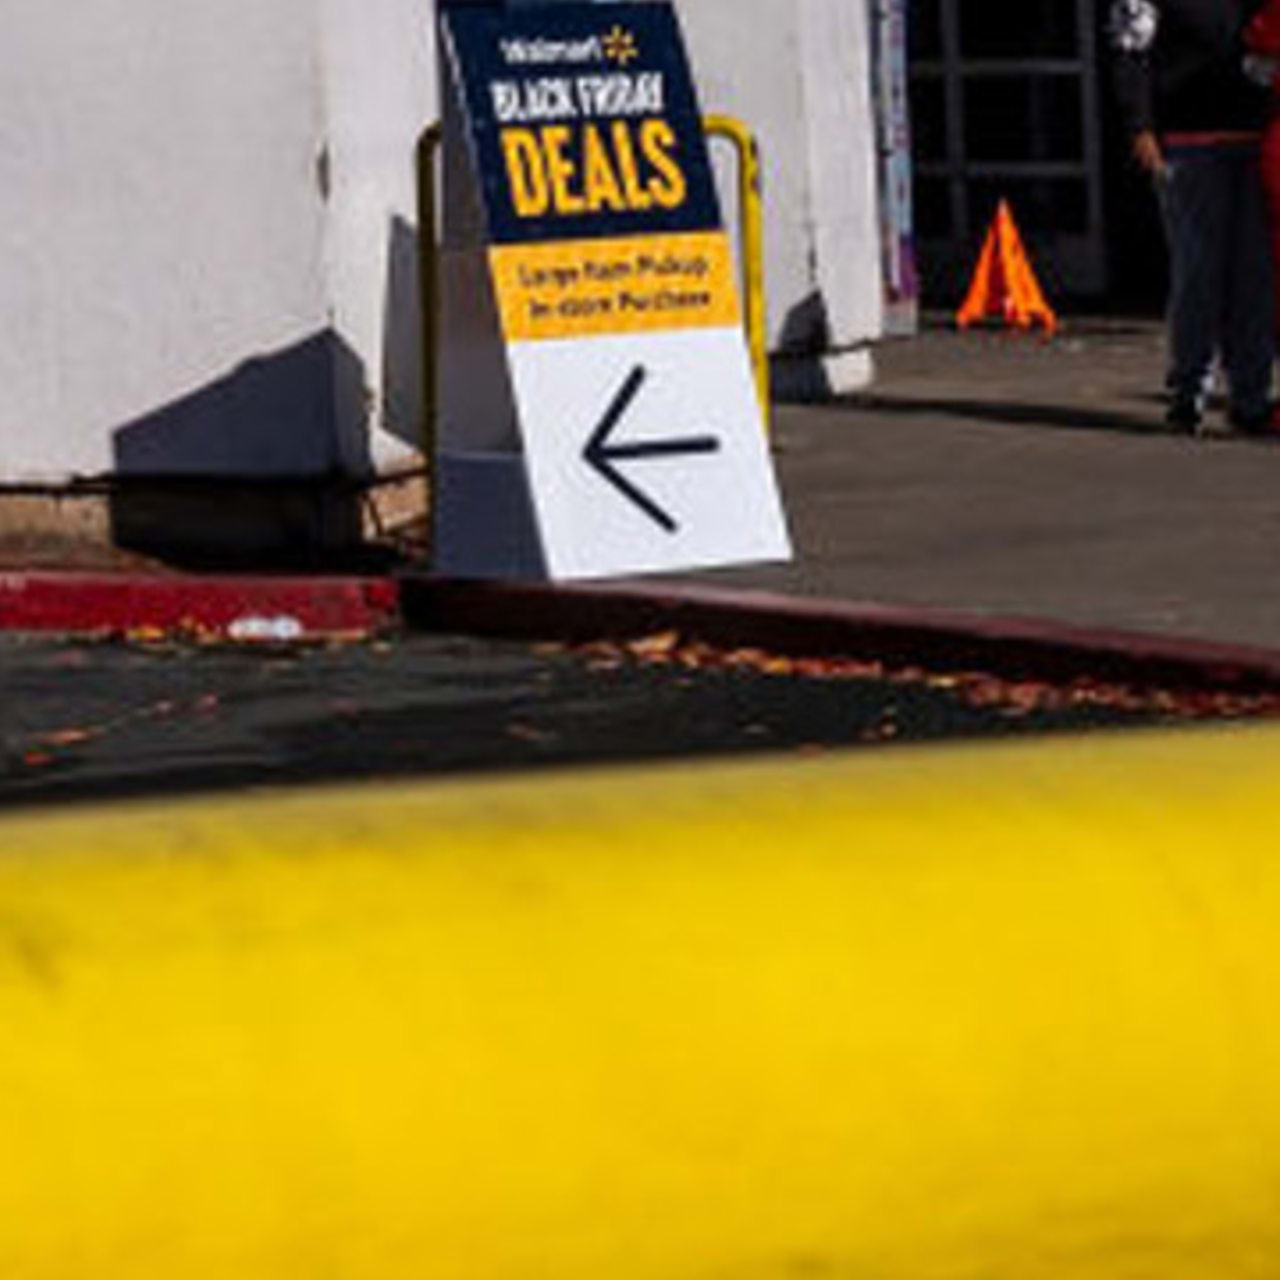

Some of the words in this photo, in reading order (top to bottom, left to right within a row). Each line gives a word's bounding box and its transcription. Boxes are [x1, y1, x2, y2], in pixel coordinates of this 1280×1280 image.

[491, 77, 577, 121] BLACK
[576, 72, 663, 114] FRIDAY
[500, 120, 686, 217] DEALS
